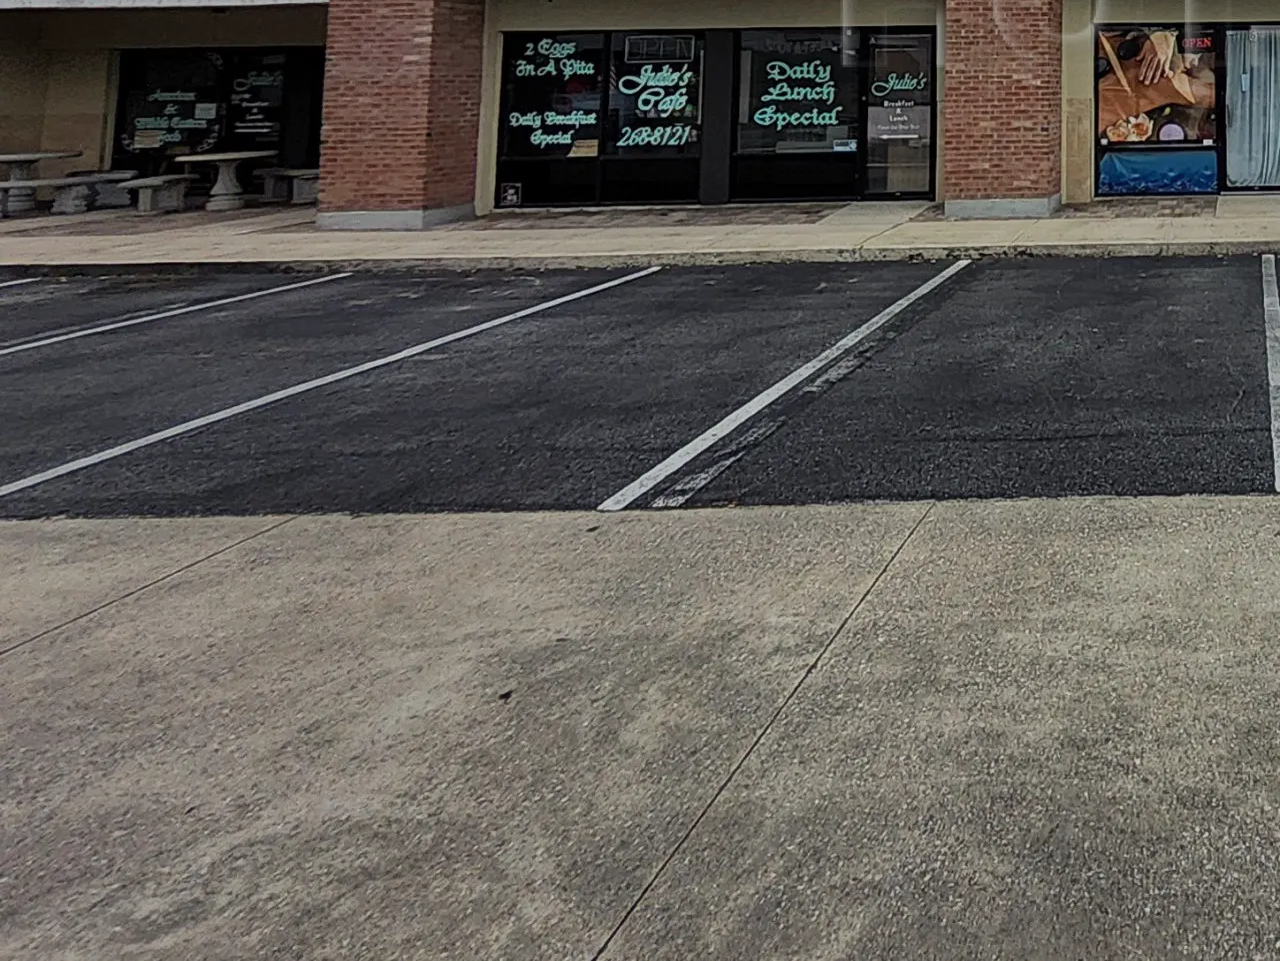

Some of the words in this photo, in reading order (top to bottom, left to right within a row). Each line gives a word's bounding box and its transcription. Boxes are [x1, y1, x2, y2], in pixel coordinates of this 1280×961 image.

[538, 38, 576, 57] Eggs
[1182, 37, 1212, 48] OPEN
[537, 61, 557, 76] A
[560, 59, 595, 80] Pita
[618, 63, 693, 94] Julie's
[766, 59, 831, 82] Daily
[761, 81, 835, 105] Lunch
[871, 72, 927, 96] Julie's
[637, 87, 689, 117] Cafe
[509, 111, 542, 128] Daily
[544, 111, 597, 128] Breakfast
[753, 105, 843, 131] Special
[530, 129, 575, 148] Special
